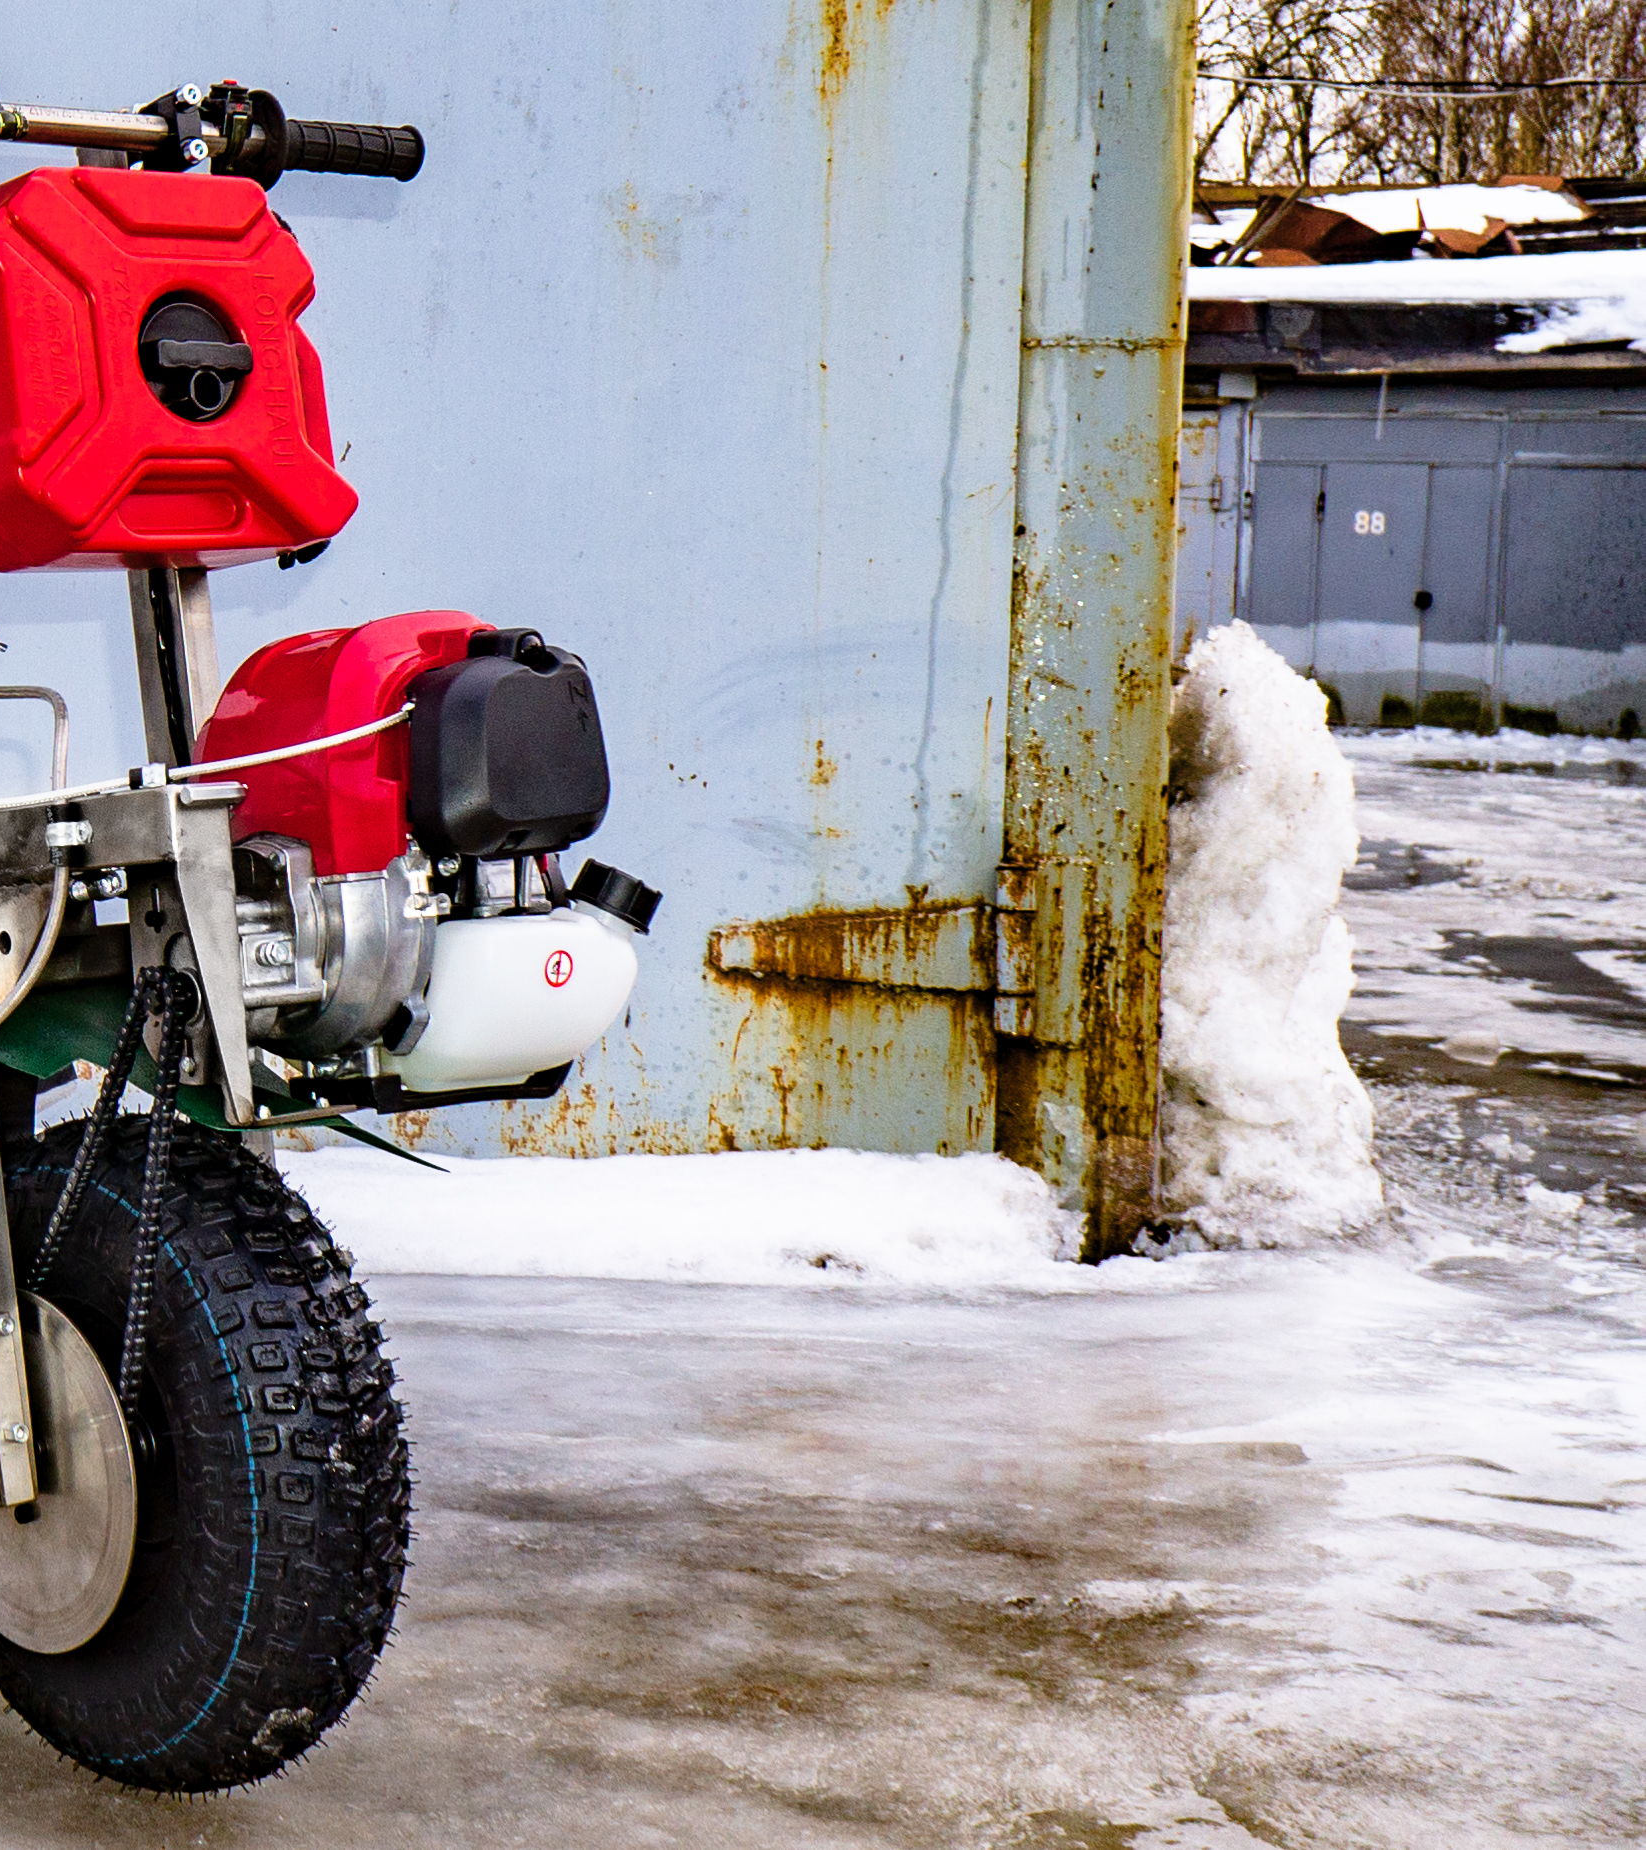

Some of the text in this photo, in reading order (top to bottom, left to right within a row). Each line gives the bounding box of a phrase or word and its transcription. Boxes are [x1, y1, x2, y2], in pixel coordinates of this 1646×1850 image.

[43, 293, 70, 407] GASOLINE
[252, 273, 295, 479] LONG HAUL
[1354, 510, 1385, 535] 88
